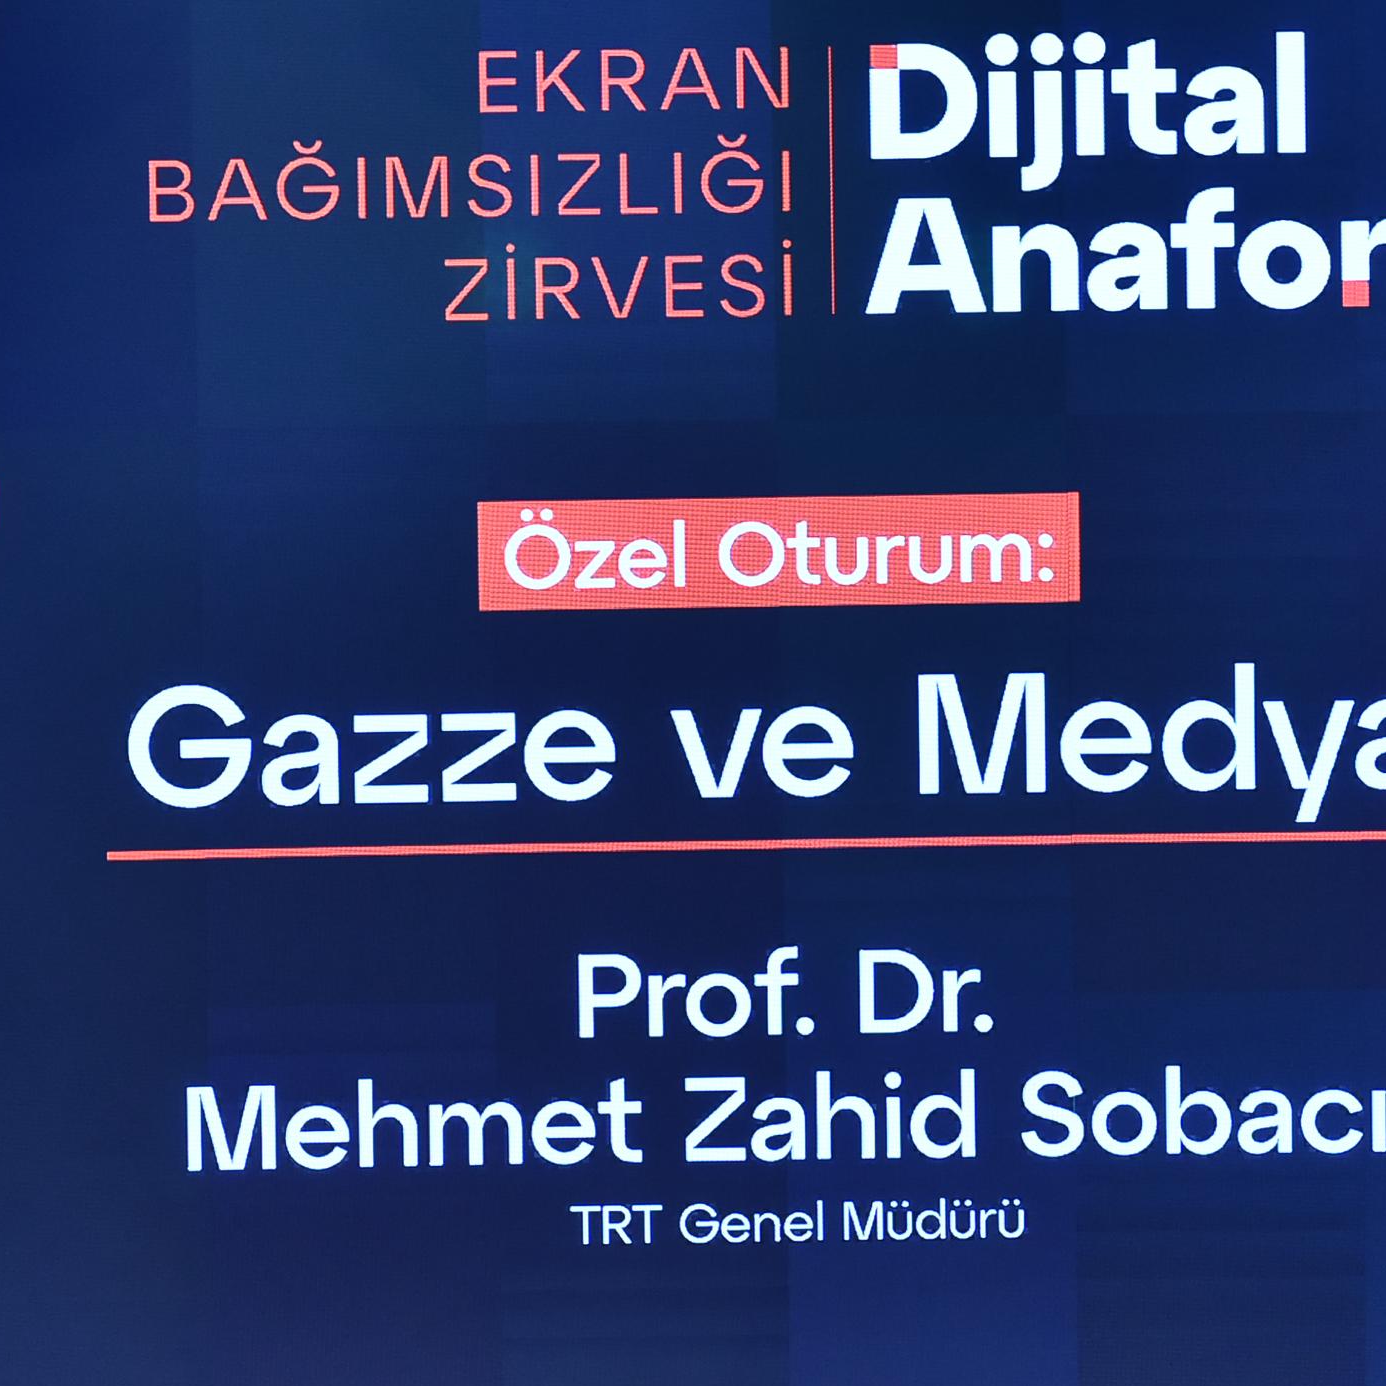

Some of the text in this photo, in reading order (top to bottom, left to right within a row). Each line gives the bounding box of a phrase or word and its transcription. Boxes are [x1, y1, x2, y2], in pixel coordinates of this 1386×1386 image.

[479, 47, 789, 113] EKRAN
[869, 32, 1306, 190] Dijital
[149, 134, 791, 222] BAĞIMSIZLIĞI
[444, 240, 792, 321] ZİRVESİ
[504, 508, 1054, 590] Özel Oturum:
[128, 685, 615, 808] Gazze
[670, 706, 853, 798] ve
[578, 946, 993, 1038] Prof. Dr.
[187, 1066, 1386, 1171] Mehmet Zahid Sobacı
[570, 1198, 1024, 1244] TRT Genel Müdürü
